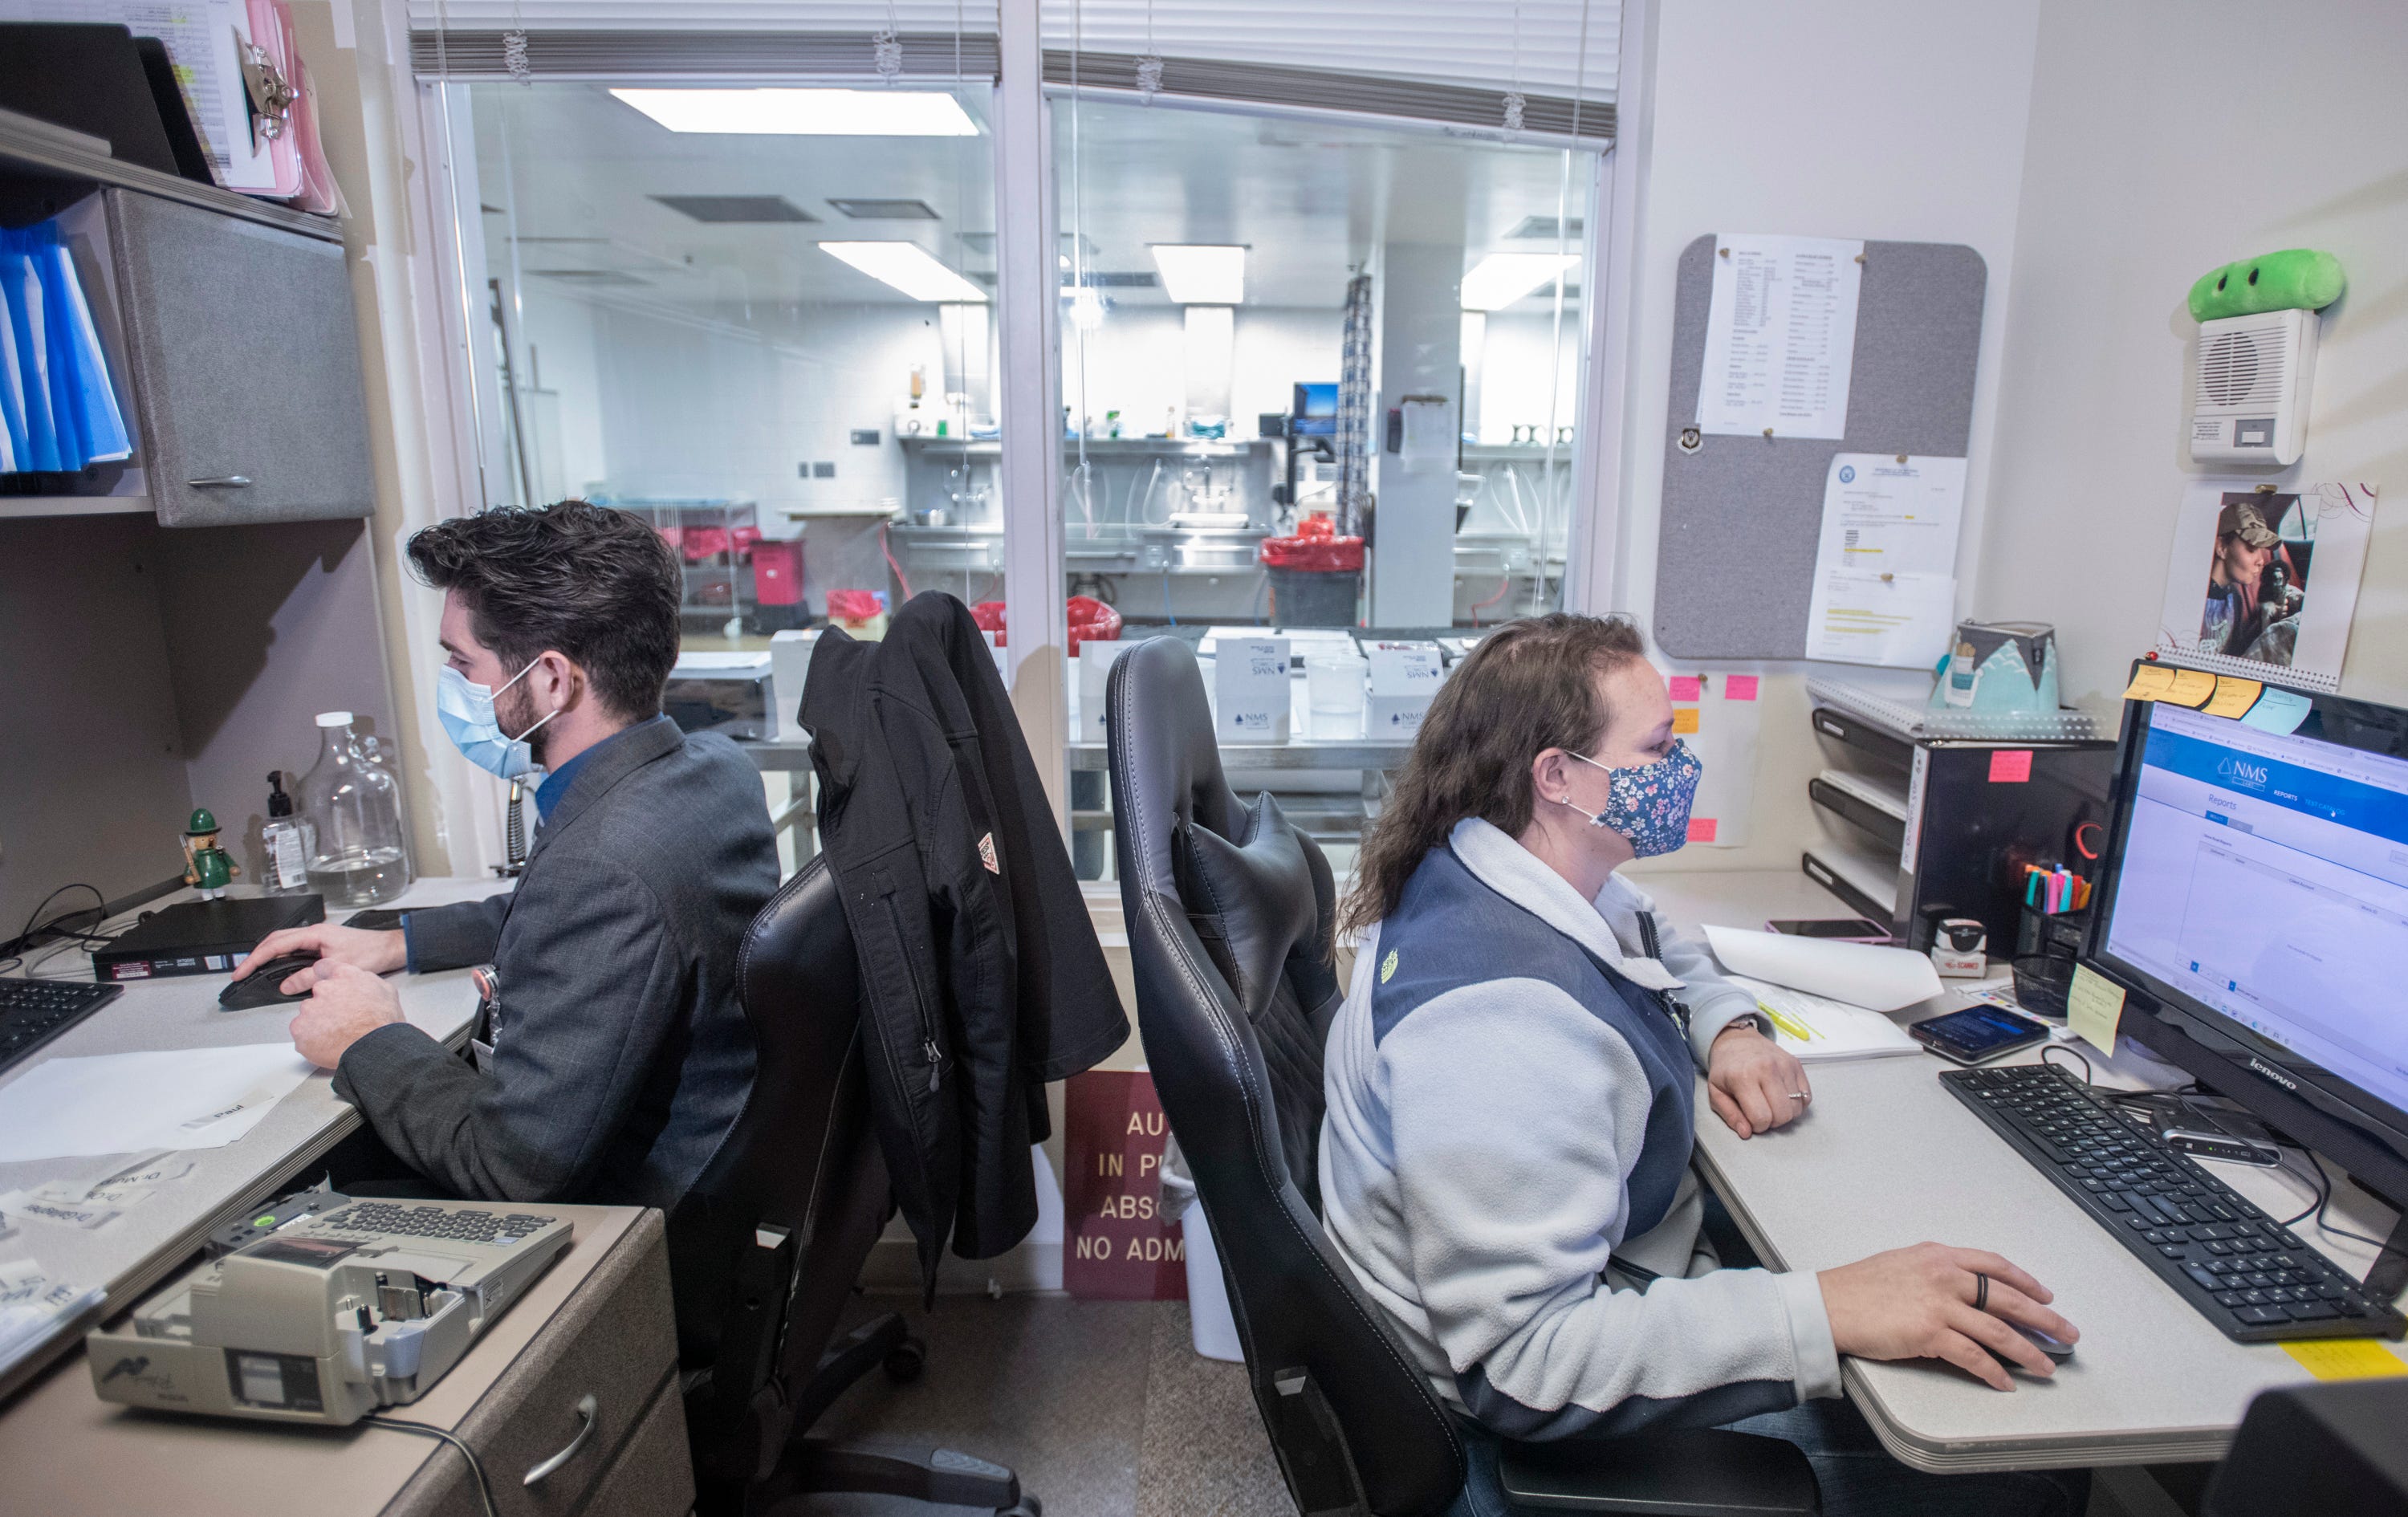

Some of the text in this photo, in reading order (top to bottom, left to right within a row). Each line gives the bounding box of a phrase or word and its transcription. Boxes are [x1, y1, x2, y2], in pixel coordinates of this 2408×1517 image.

[2233, 760, 2268, 783] NMS
[2208, 793, 2237, 811] Reports
[2273, 789, 2298, 802] REPORTS
[2250, 1057, 2296, 1090] lenovo
[214, 1104, 244, 1118] Paul
[1098, 1153, 1162, 1177] IN P
[1100, 1194, 1160, 1220] ABS
[1076, 1235, 1112, 1262] NO
